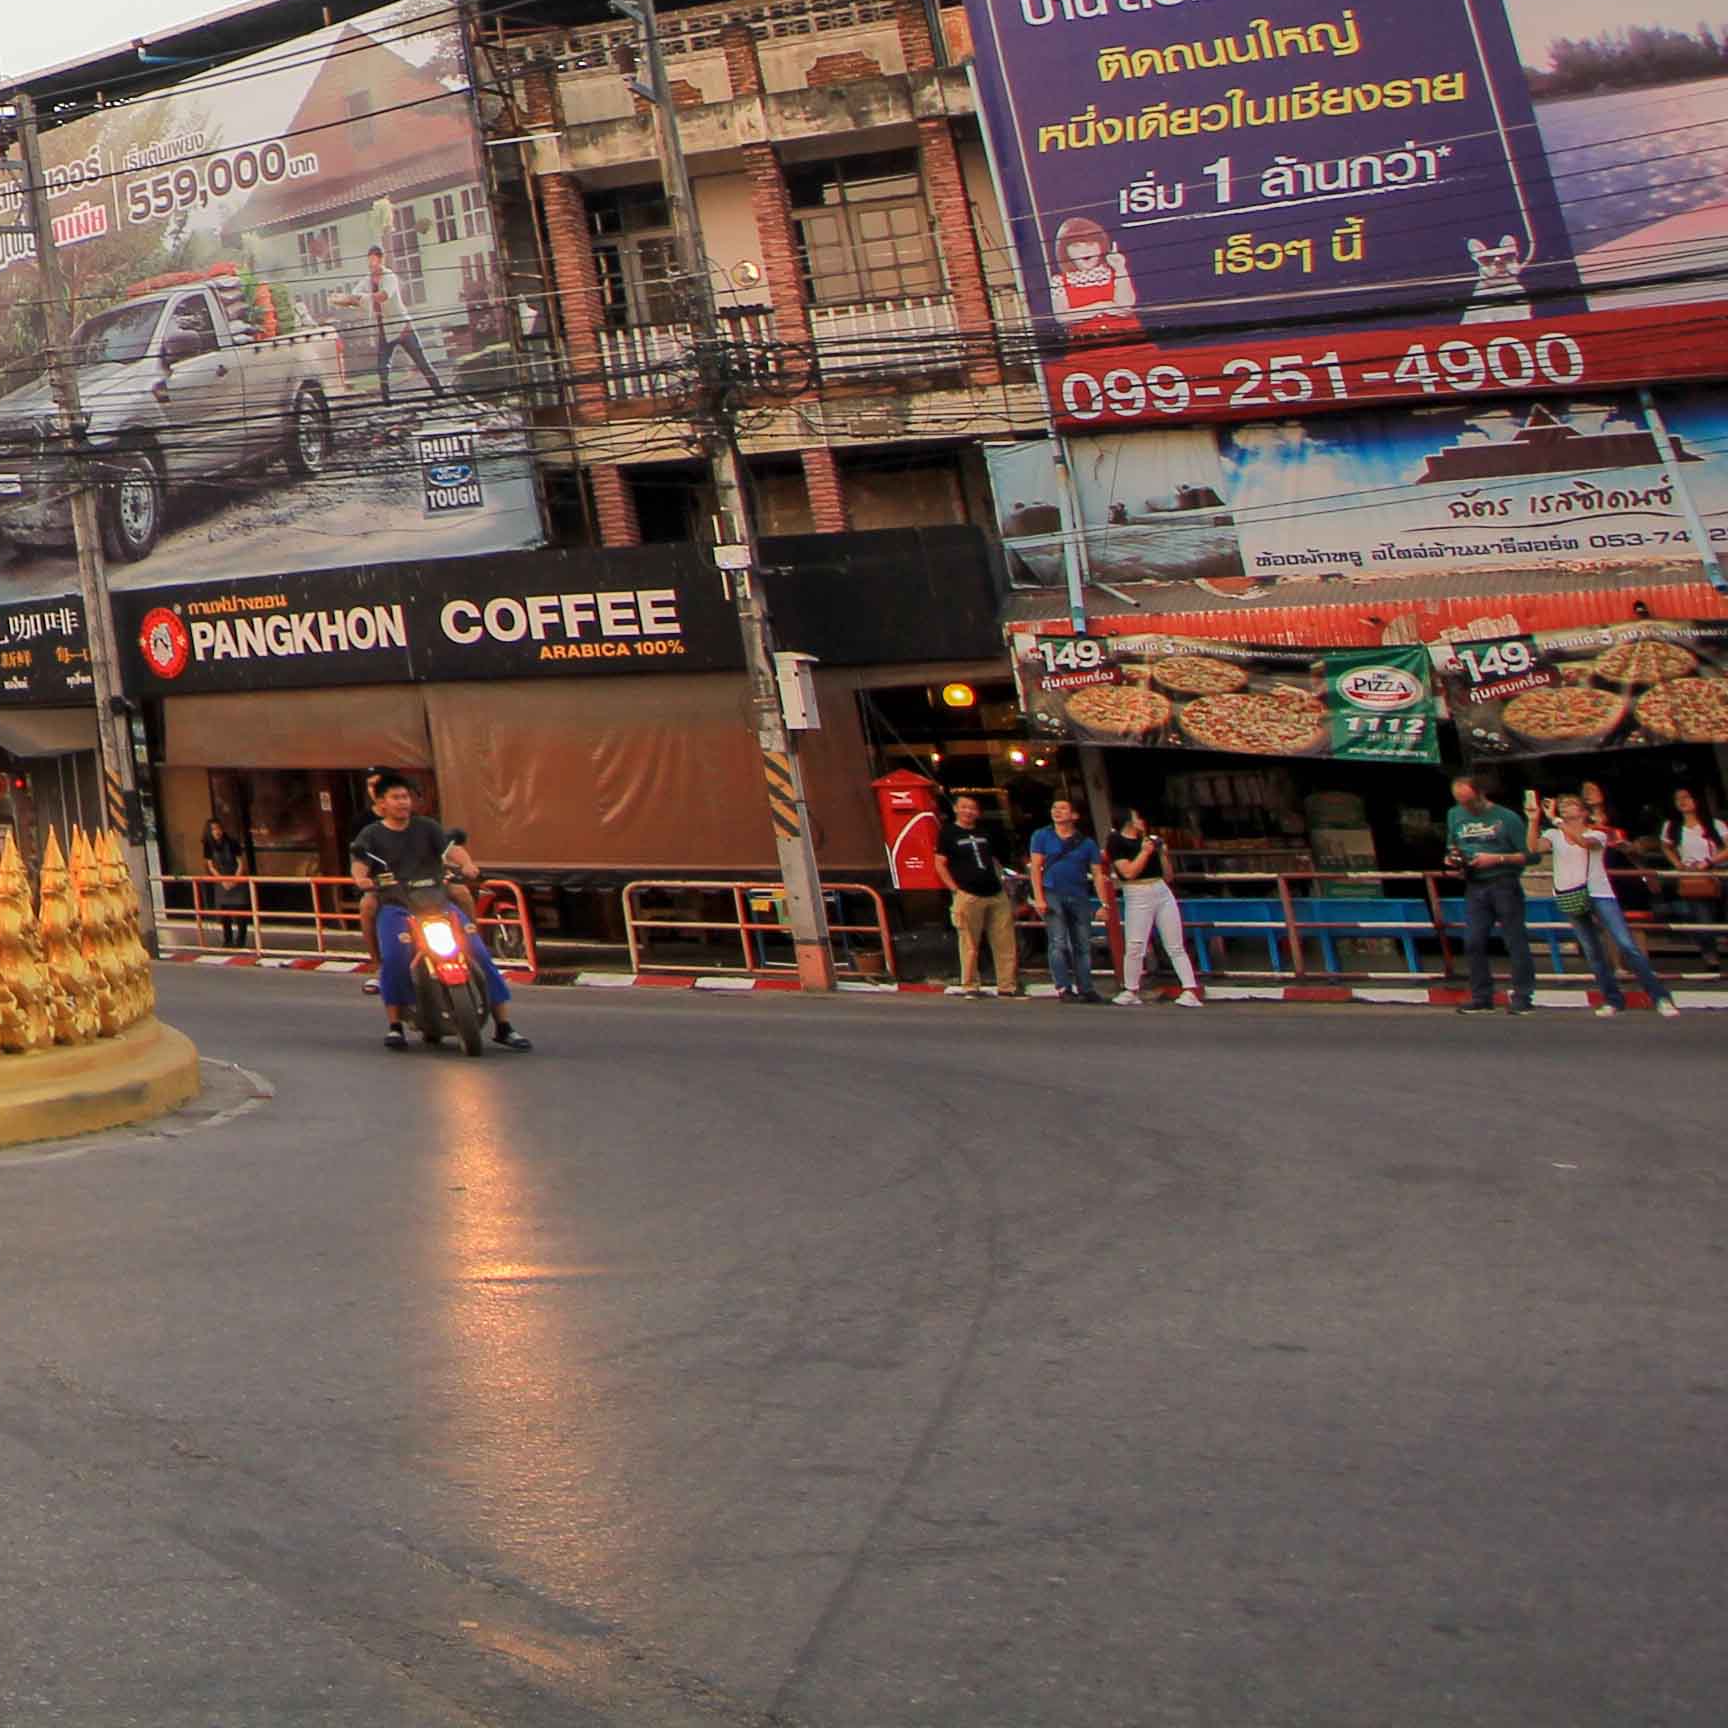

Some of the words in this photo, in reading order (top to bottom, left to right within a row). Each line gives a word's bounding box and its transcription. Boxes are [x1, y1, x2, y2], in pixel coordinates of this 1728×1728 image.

[1097, 10, 1361, 83] ติดถนนใหญ่
[1038, 71, 1466, 153] หนึ่งเดียวในเชียงราย
[127, 142, 287, 222] 559,000
[288, 155, 316, 176] บาท
[1119, 171, 1184, 215] เริ่ม
[1203, 157, 1232, 203] 1
[1214, 233, 1312, 276] เร็วๆ
[1332, 217, 1364, 263] นี้
[1061, 332, 1584, 420] 099-251-4900
[427, 484, 480, 508] TOUGH
[1448, 487, 1512, 519] ฉัตร
[1255, 545, 1362, 569] ห้องพักหรู
[190, 604, 408, 662] PANGKHON
[440, 589, 682, 645] COFFEE
[540, 641, 631, 660] ARABICA
[634, 639, 685, 656] 100%
[1354, 677, 1408, 692] PIZZA
[1345, 717, 1426, 733] 1112
